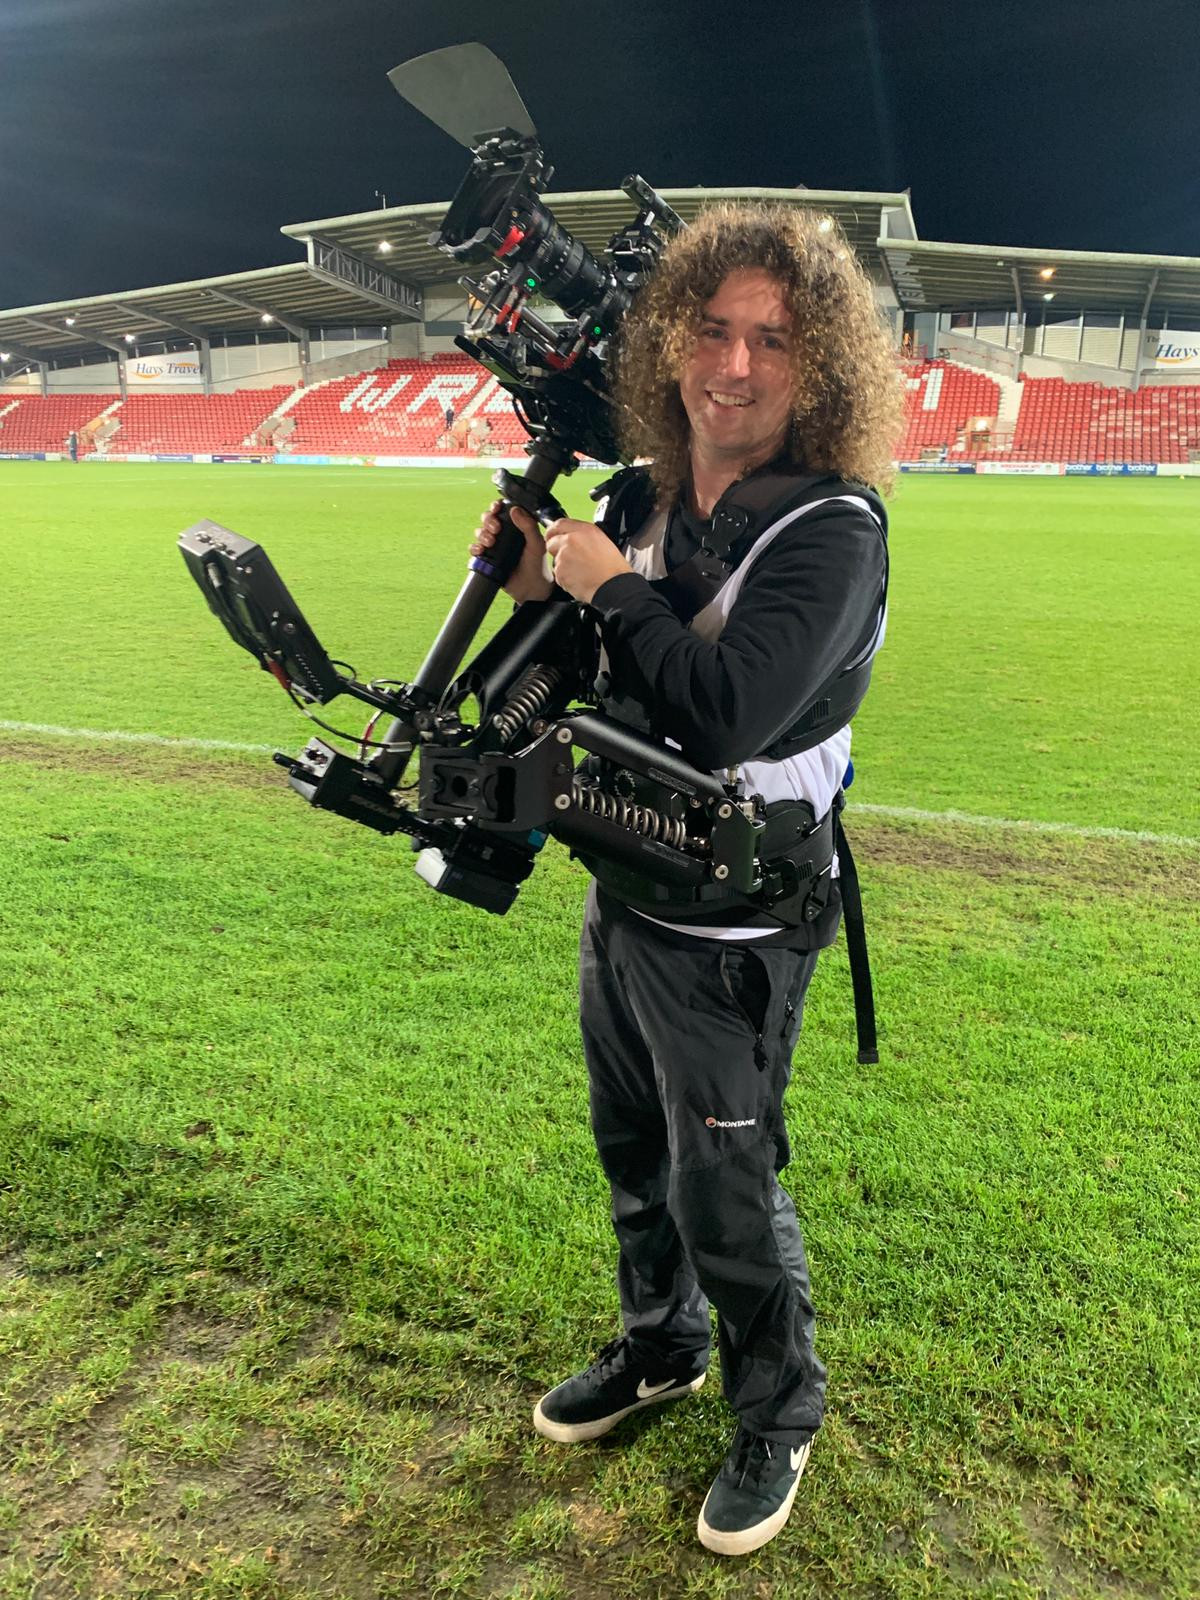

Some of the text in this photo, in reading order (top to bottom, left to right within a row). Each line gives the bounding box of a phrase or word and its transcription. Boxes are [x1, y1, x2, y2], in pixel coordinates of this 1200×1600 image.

[1155, 344, 1198, 360] Hays
[136, 363, 204, 375] Hays Travel
[716, 1118, 756, 1128] MONTANE
